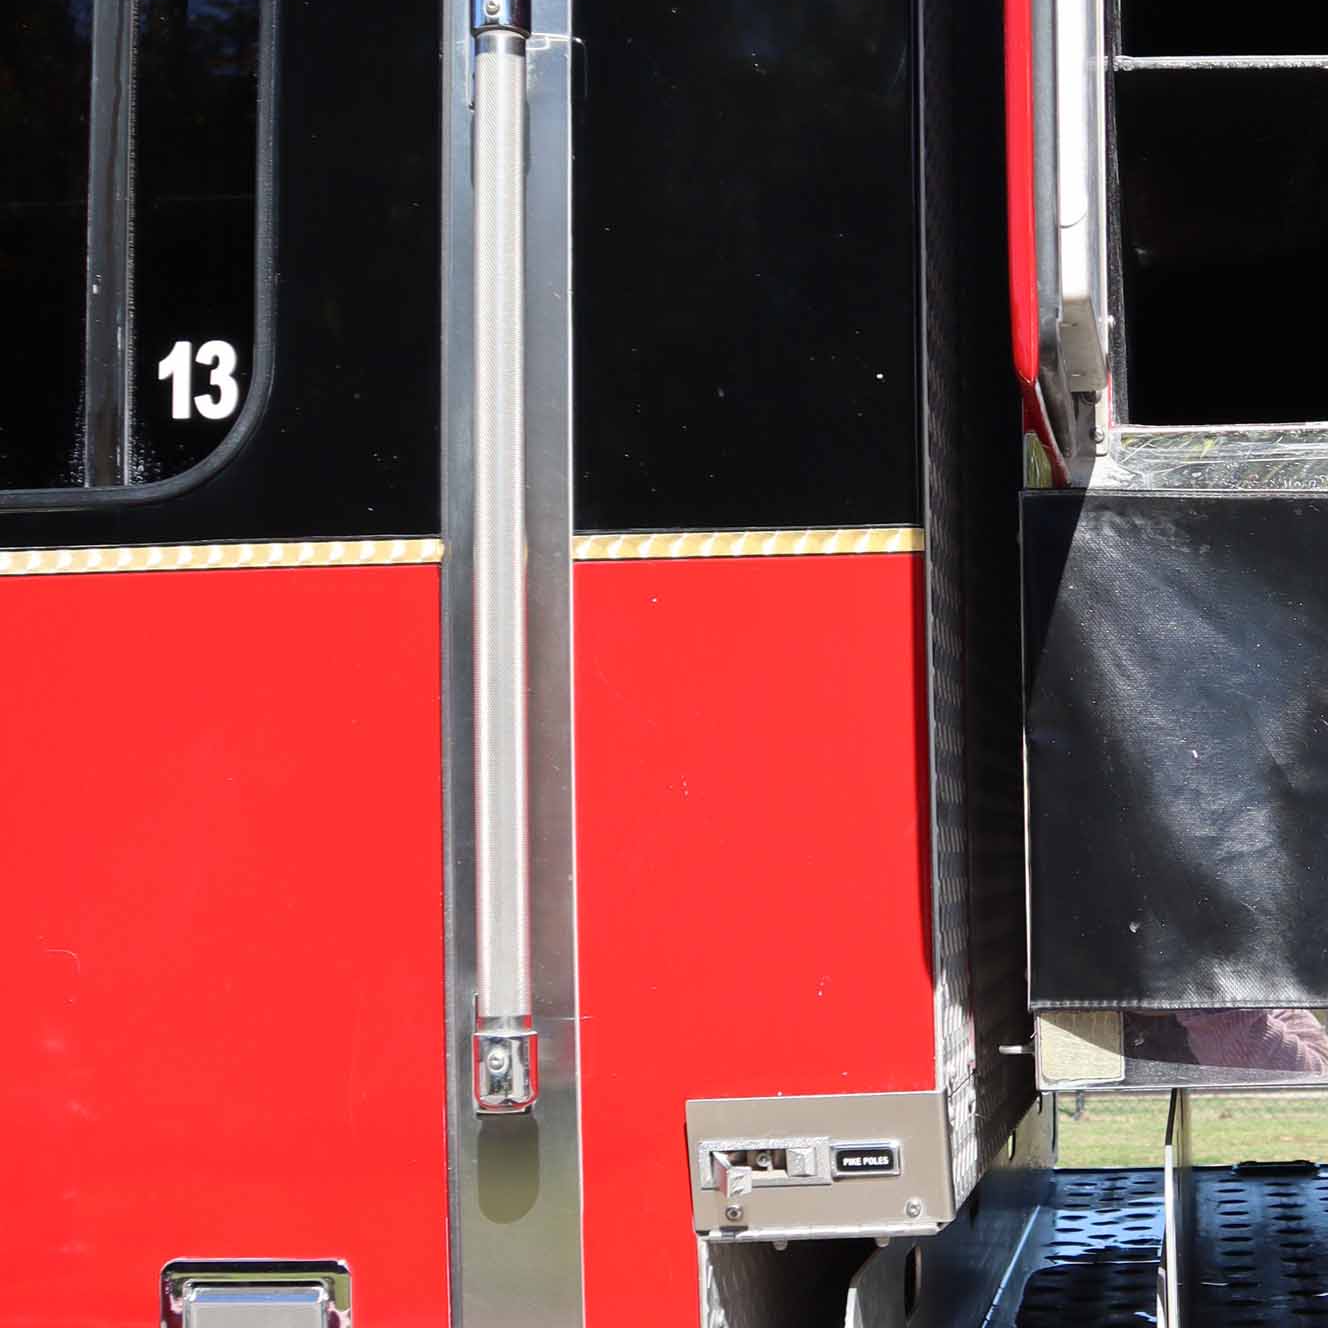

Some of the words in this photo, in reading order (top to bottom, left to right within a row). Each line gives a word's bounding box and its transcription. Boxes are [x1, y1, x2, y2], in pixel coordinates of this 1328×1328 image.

[158, 340, 239, 420] 13
[843, 1157, 862, 1166] PIKE
[862, 1156, 889, 1166] POLES
